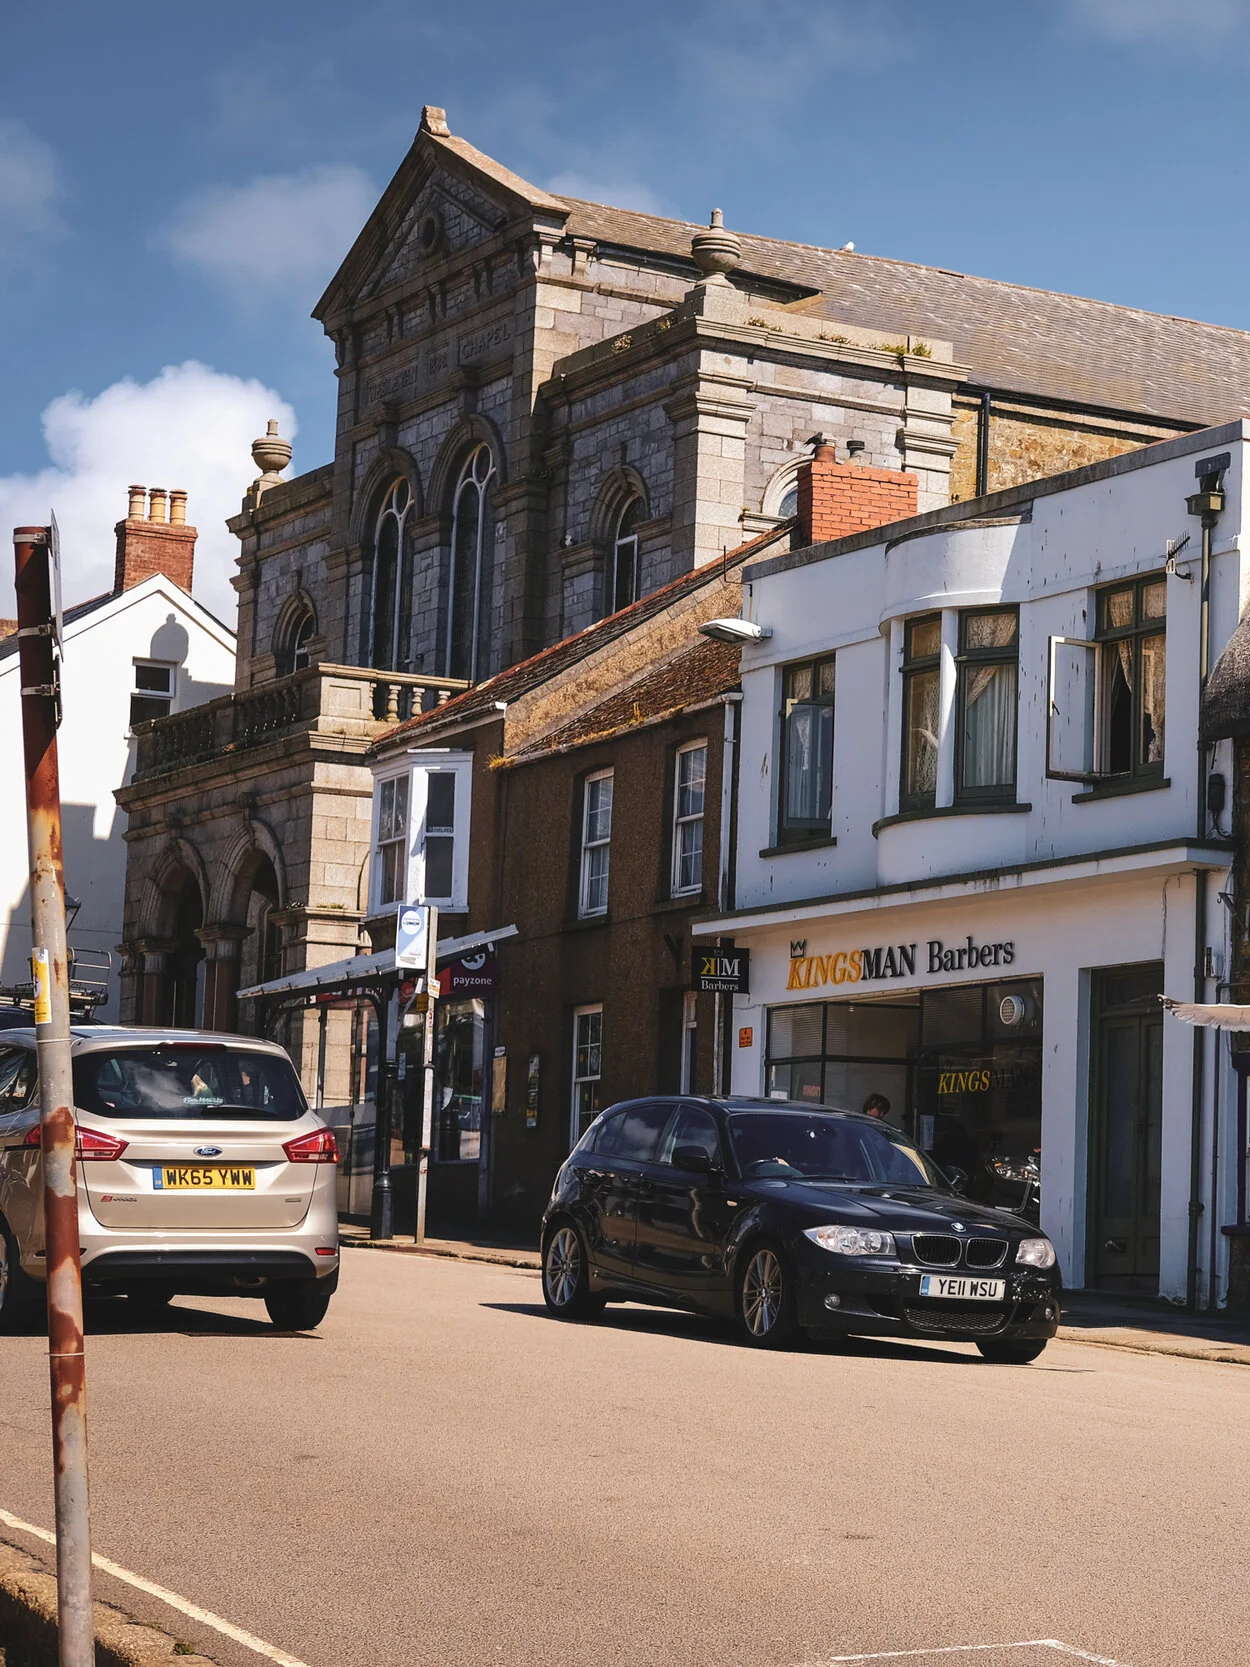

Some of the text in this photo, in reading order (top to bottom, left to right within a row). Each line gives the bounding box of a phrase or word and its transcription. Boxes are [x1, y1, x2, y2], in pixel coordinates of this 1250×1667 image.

[786, 936, 1015, 990] KINGSMAN Barbers
[453, 977, 492, 987] payzone
[701, 980, 739, 991] Barbers
[166, 1169, 252, 1185] WK65 YWW
[970, 1281, 998, 1297] WSU
